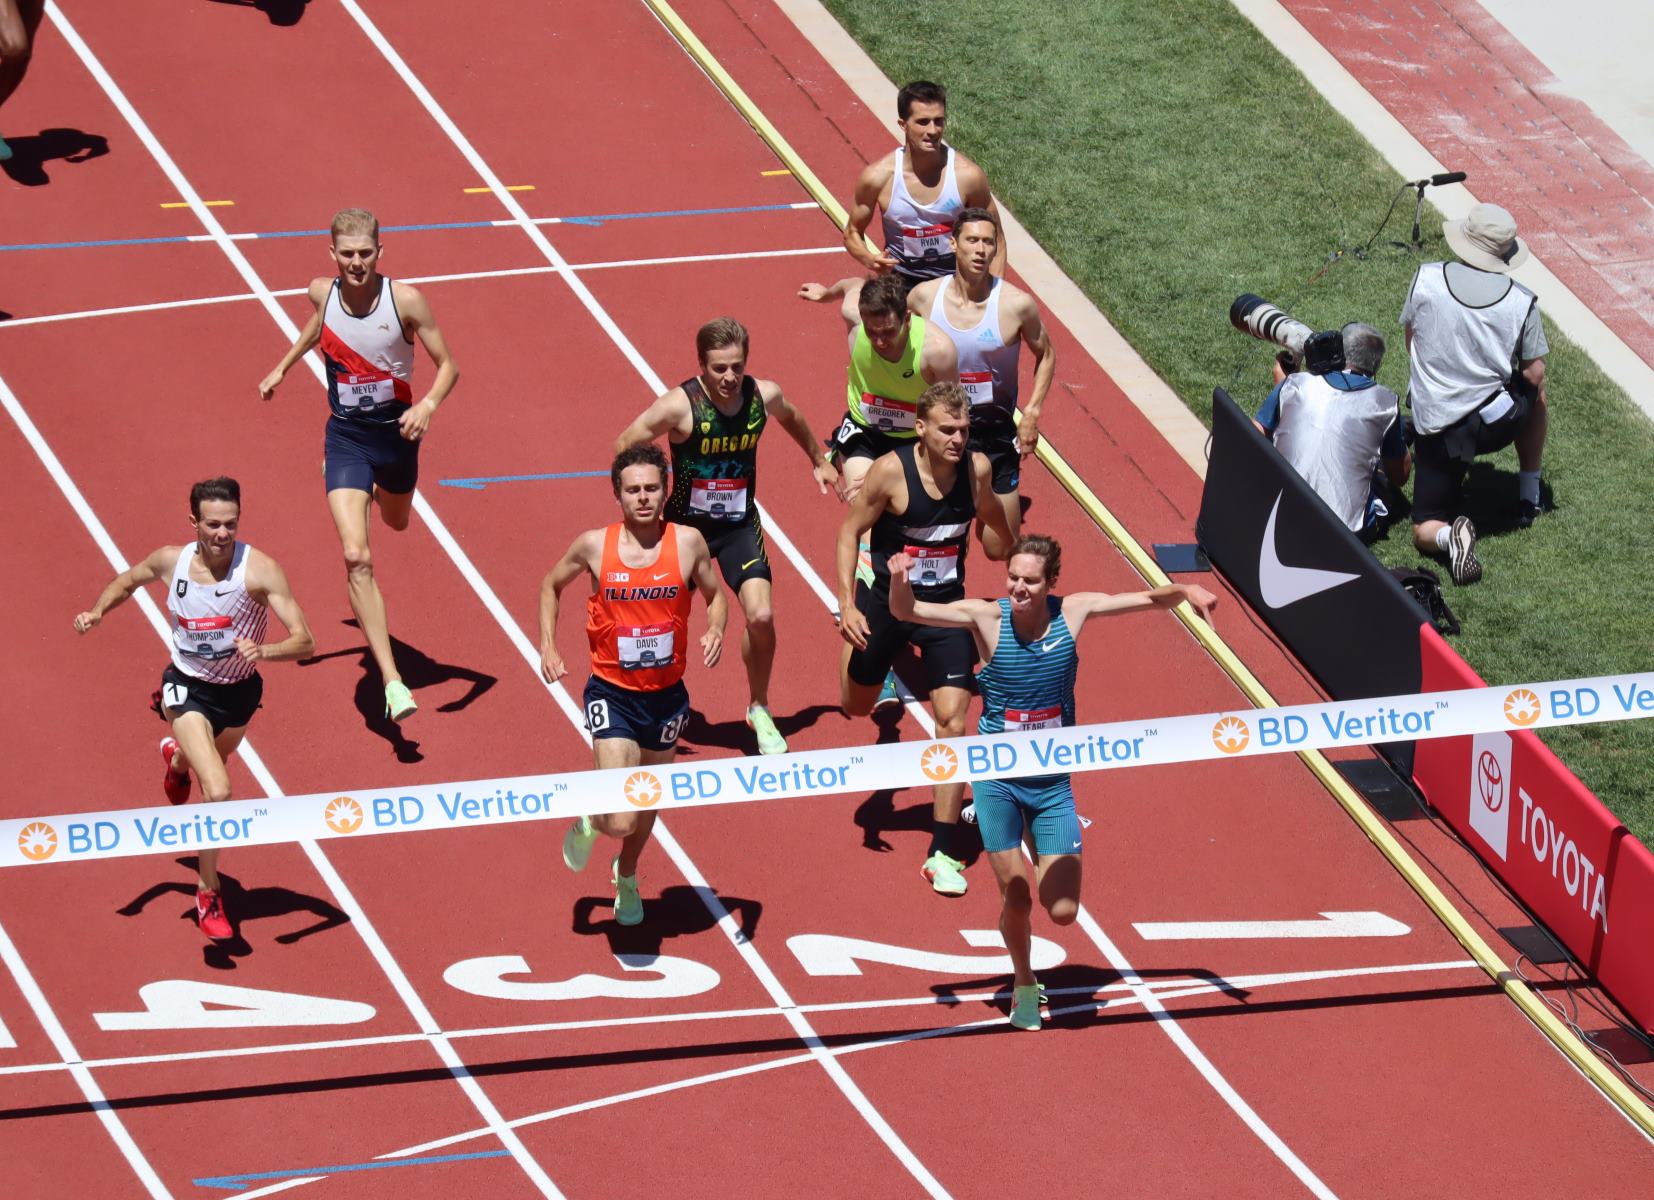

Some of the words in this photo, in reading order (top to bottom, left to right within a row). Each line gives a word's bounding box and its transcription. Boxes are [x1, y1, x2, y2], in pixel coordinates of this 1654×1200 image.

[920, 238, 940, 248] RYAN
[351, 384, 378, 395] MEYER
[868, 406, 906, 418] GREGOREK
[701, 436, 757, 455] OREGON
[706, 492, 732, 501] BROWN
[921, 559, 939, 568] HOLT
[605, 585, 679, 602] ILLINOIS
[186, 631, 225, 642] THOMPSON
[636, 639, 658, 649] DAVIS
[168, 684, 179, 702] 1
[1550, 688, 1600, 719] BD
[590, 702, 605, 728] 8
[664, 718, 679, 742] 8
[1258, 715, 1309, 747] BD
[966, 744, 1017, 775] BD
[670, 770, 721, 801] BD
[373, 797, 424, 827] BD
[68, 821, 120, 854] BD
[1518, 786, 1607, 935] TOYOTA
[1132, 911, 1411, 940] 1
[786, 929, 1067, 976] 2
[443, 954, 721, 1001] 3
[93, 980, 376, 1031] 4
